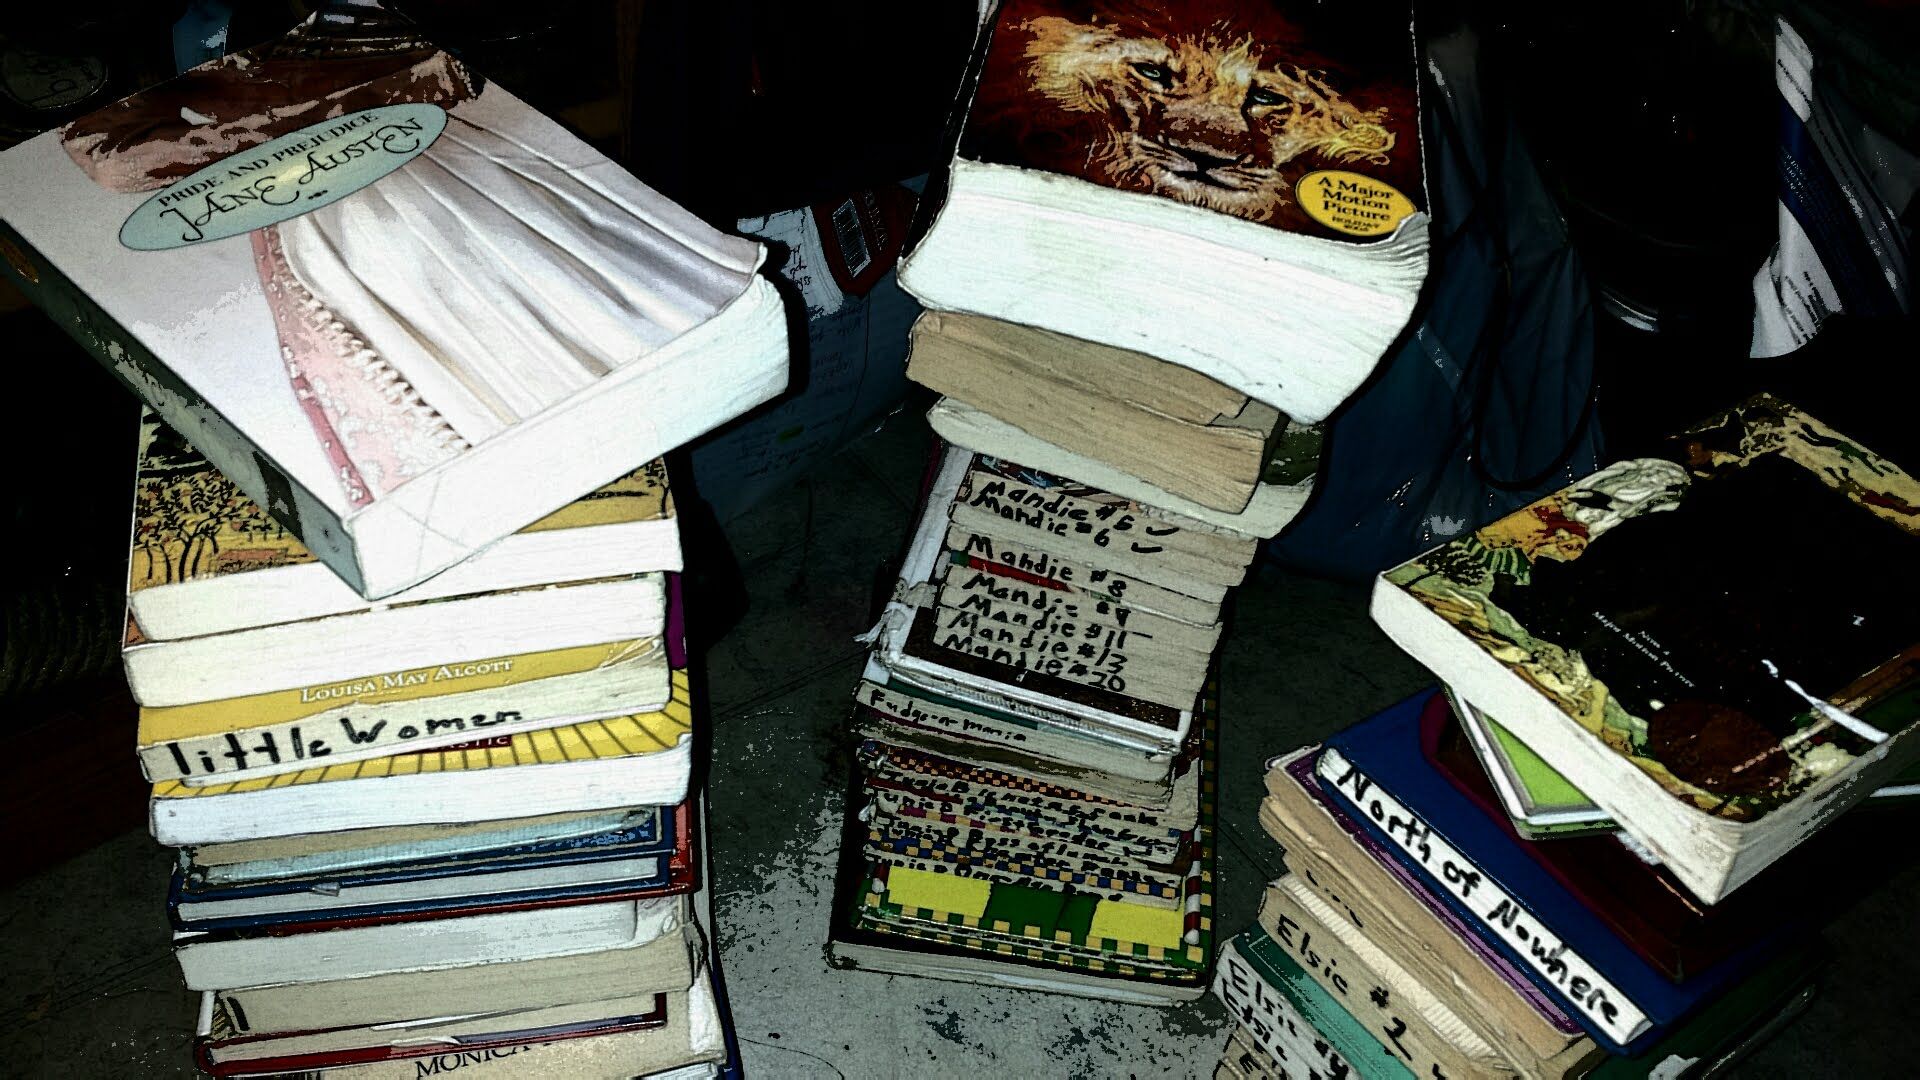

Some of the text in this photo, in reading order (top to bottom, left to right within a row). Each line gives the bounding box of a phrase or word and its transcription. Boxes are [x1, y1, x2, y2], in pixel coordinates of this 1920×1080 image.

[158, 112, 380, 208] PRIDE AND PREJUDICE
[159, 117, 424, 242] JANE AUSTEN
[1318, 176, 1394, 199] A Major
[1322, 187, 1391, 210] Motion
[1323, 200, 1391, 221] Picture
[970, 494, 1067, 537] Mandie
[980, 481, 1088, 521] Mandie
[967, 533, 1073, 582] Mandie
[959, 594, 1076, 637] Mandie
[962, 572, 1078, 618] Mandie
[943, 633, 1064, 678] Mandie
[948, 611, 1070, 660] Mandie
[300, 659, 514, 704] LOUISA MAY ALCOTT
[340, 708, 523, 745] Women
[1337, 765, 1622, 1028] North of Nowhere
[1276, 912, 1348, 996] Elsie
